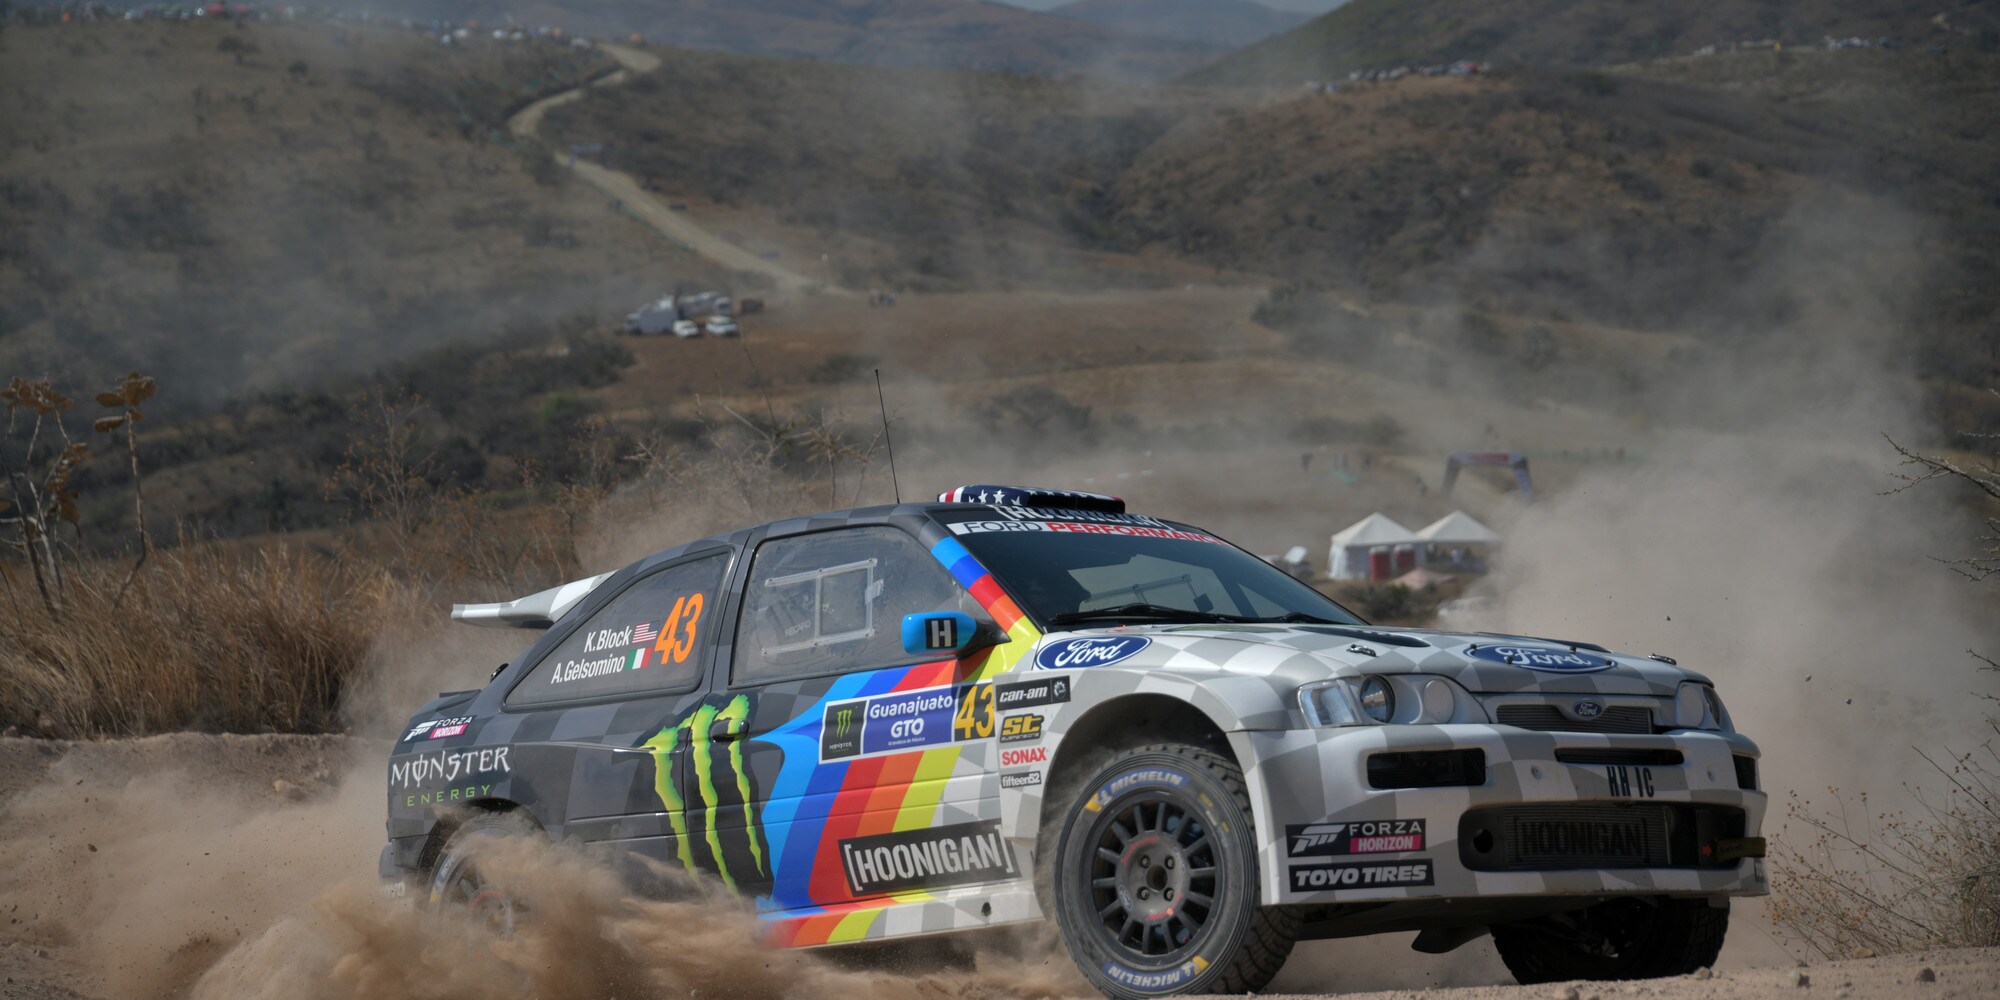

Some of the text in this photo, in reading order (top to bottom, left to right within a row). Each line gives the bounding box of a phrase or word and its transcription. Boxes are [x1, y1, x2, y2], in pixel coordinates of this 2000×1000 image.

[963, 521, 1043, 533] FORD
[584, 625, 633, 653] K.Block
[654, 592, 704, 665] 43
[931, 619, 952, 648] H
[1054, 637, 1131, 667] Ford
[1494, 646, 1592, 666] Ford
[551, 653, 626, 684] A.Gelsomino
[999, 685, 1048, 703] can-am
[869, 694, 953, 719] Guanajuato
[955, 683, 994, 739] 43
[1577, 702, 1597, 717] Ford
[433, 725, 464, 738] HORIZON
[435, 716, 472, 727] FORZA
[890, 717, 925, 738] GTO
[390, 746, 511, 789] MONSTER
[1002, 747, 1047, 766] SONAX
[1002, 772, 1040, 787] fifteen52
[1110, 770, 1184, 794] MICHELIN
[407, 784, 490, 807] ENERGY
[1349, 821, 1422, 836] FORZA
[1358, 836, 1414, 852] HORIZON
[1295, 864, 1428, 887] TOYO TIRES
[1107, 965, 1181, 987] MICHELIN
